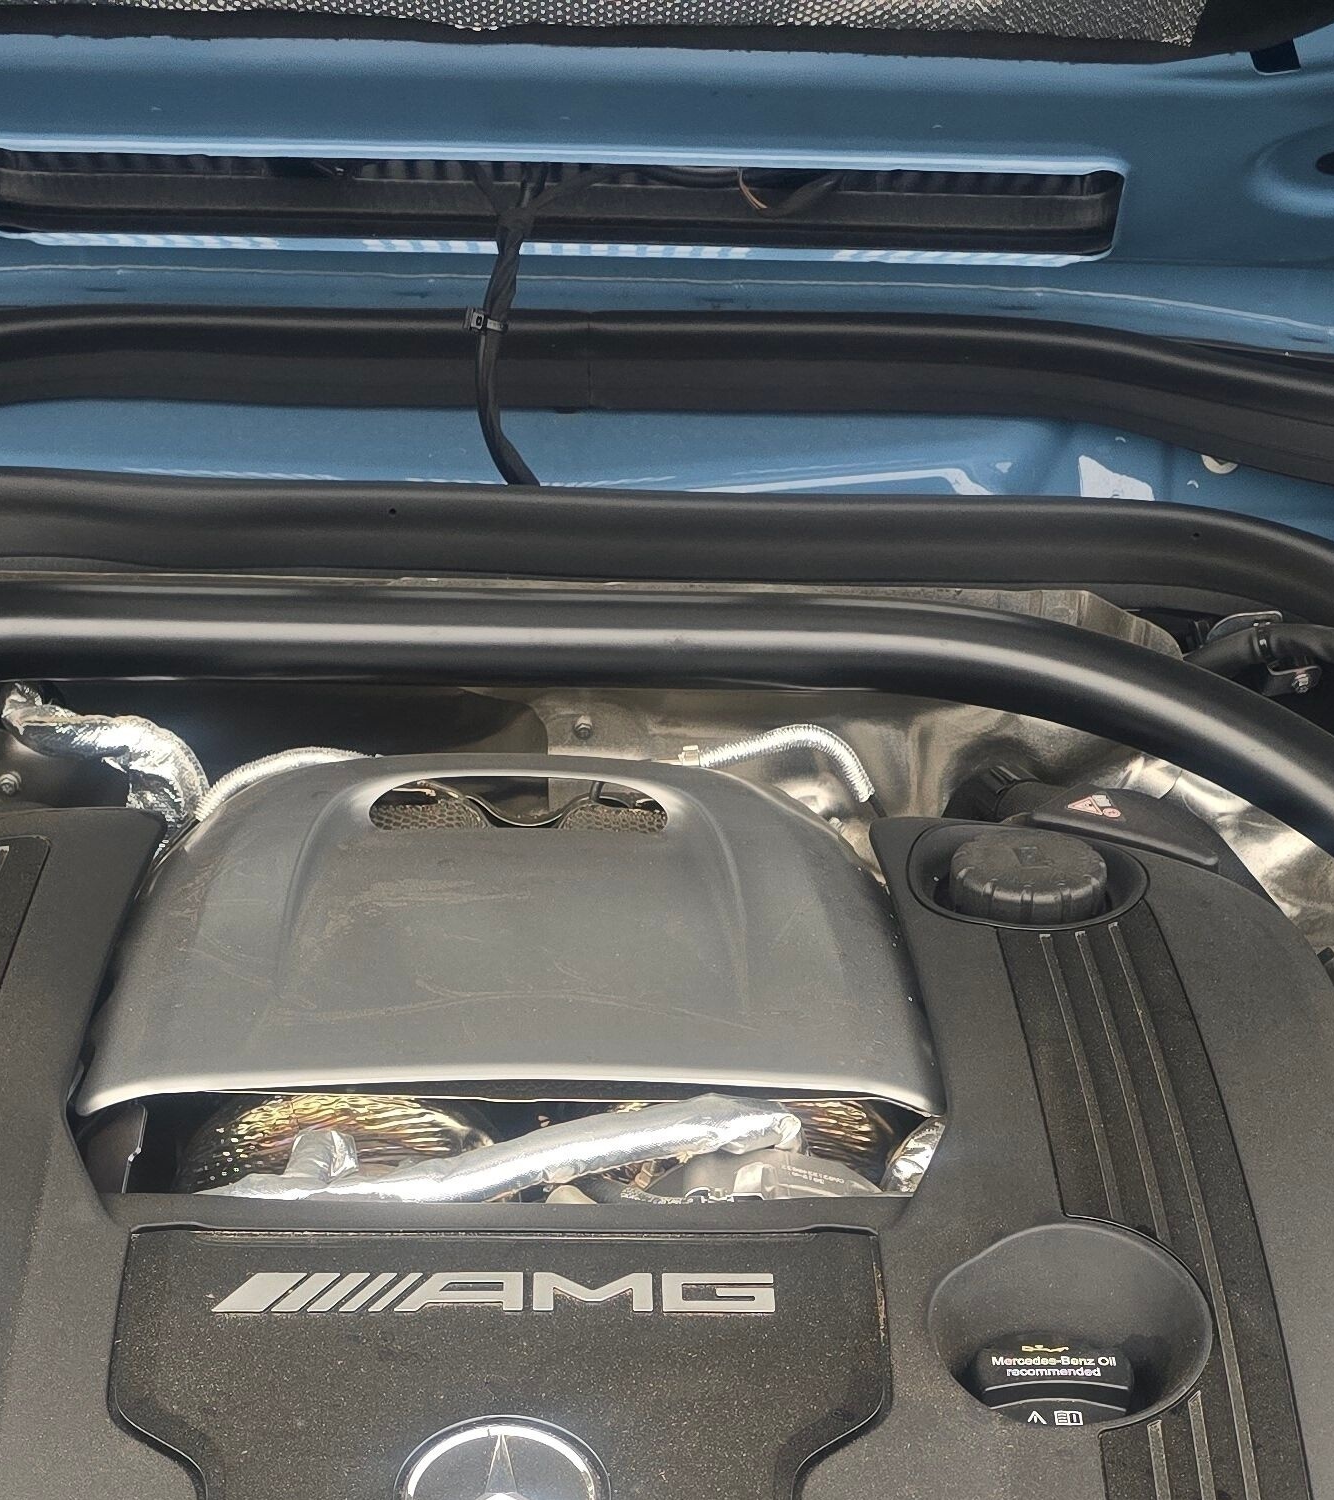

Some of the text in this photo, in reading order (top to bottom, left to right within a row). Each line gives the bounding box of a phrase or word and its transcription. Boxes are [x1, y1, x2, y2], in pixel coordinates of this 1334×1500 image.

[393, 1272, 775, 1313] AMG
[991, 1355, 1117, 1367] Mercedes-Benz Oil
[1006, 1367, 1102, 1377] recommended
